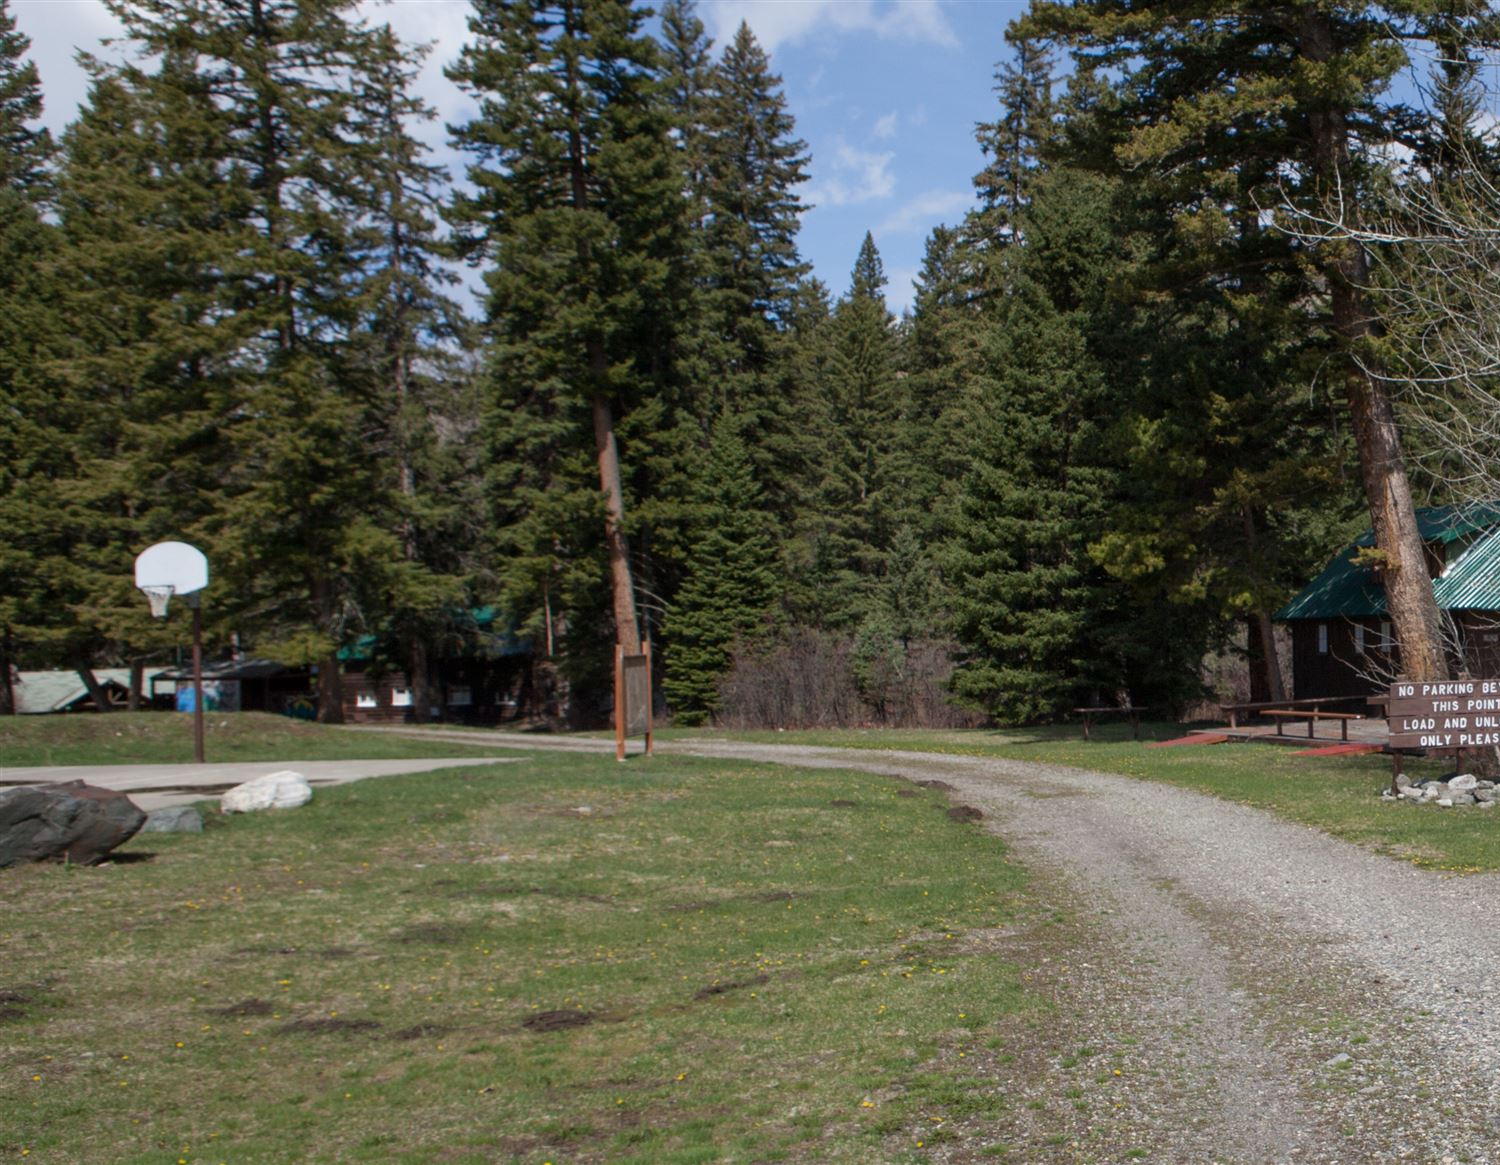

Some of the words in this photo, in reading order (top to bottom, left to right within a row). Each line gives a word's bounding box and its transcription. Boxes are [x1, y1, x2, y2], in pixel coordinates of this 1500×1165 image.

[1398, 685, 1414, 697] NO
[1422, 683, 1474, 696] PARKING
[1432, 701, 1459, 712] THIS
[1403, 718, 1436, 730] LOAD
[1443, 717, 1468, 729] AND
[1420, 734, 1452, 746] ONLY
